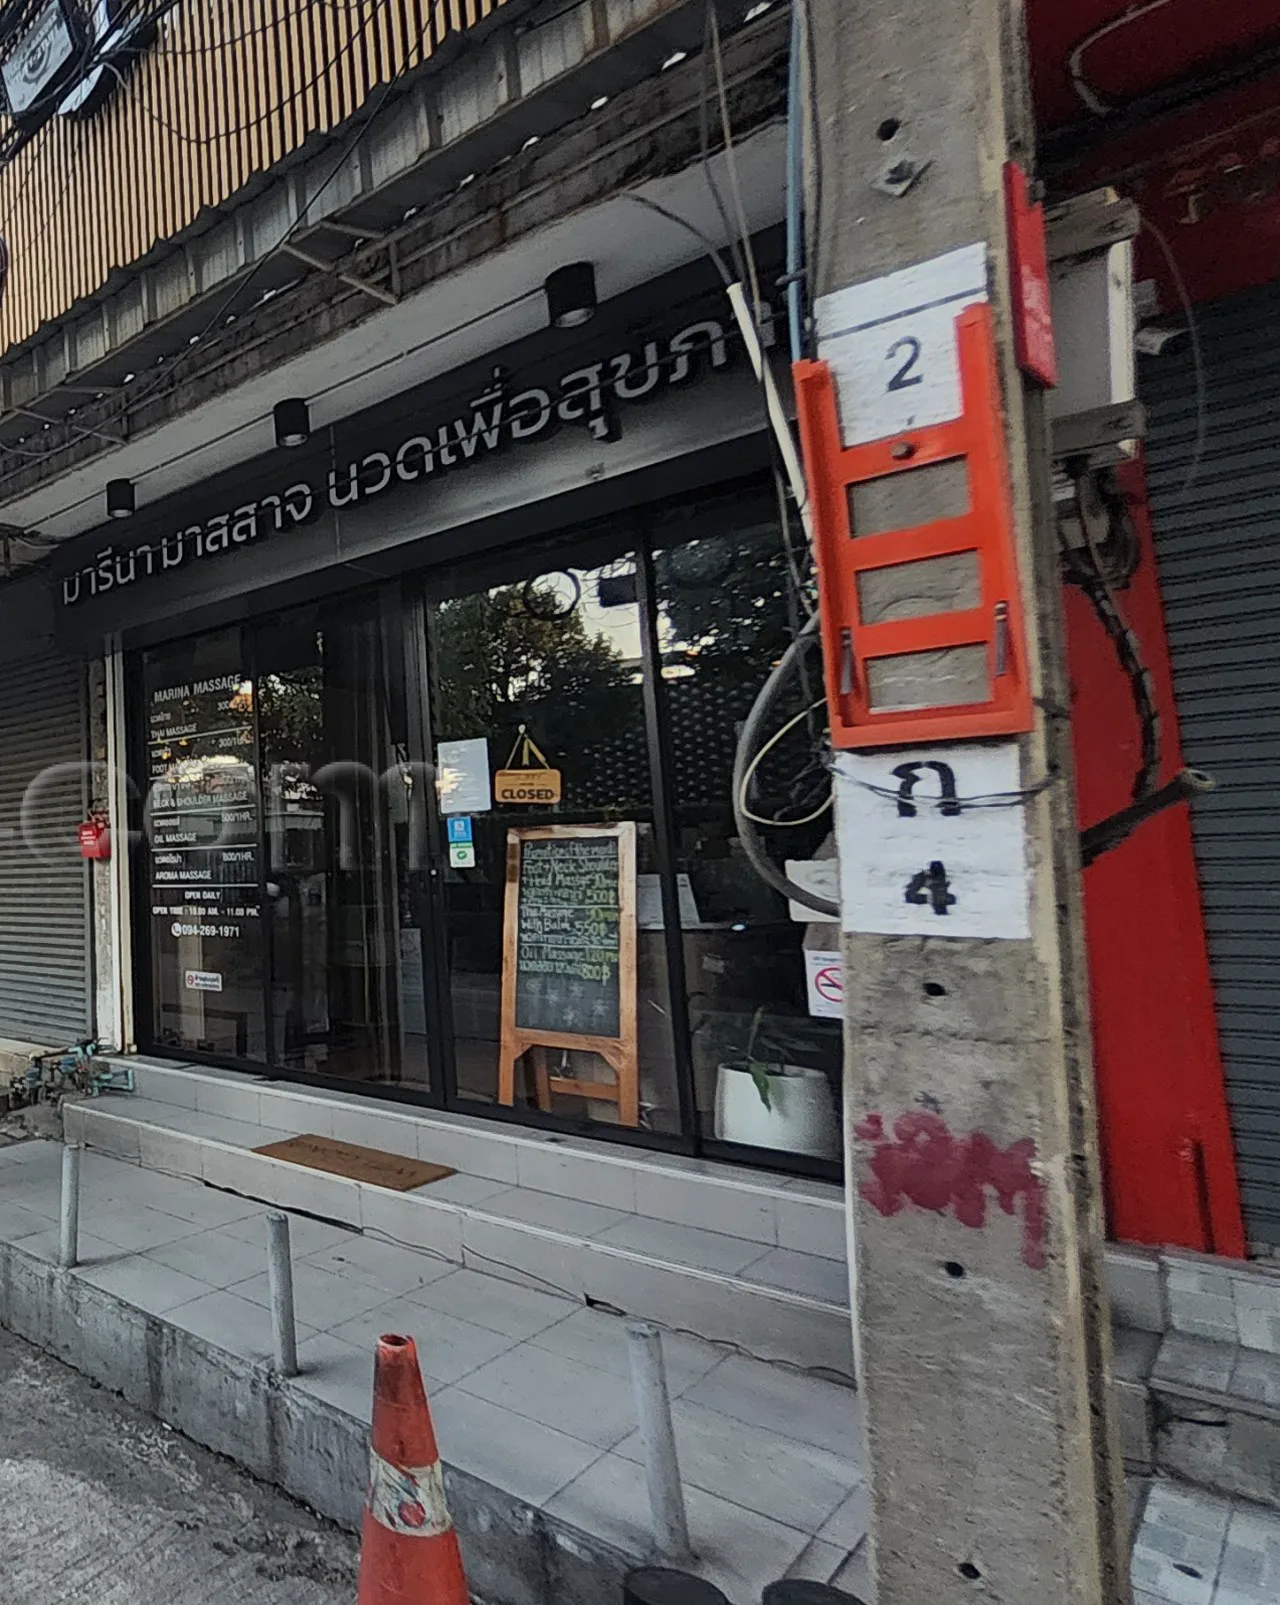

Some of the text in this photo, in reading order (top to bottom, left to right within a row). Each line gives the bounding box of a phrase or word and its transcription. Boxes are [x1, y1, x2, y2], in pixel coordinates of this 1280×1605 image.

[883, 335, 924, 393] 2
[153, 674, 241, 703] MARINA MASSAGE
[166, 723, 197, 736] MASSAGE
[501, 788, 555, 801] CLOSED
[166, 832, 197, 842] MASSAGE
[155, 870, 212, 880] AROMA MASSAGE
[184, 890, 221, 899] OPEN DAILY
[903, 860, 957, 916] 4
[152, 906, 168, 915] OPEN
